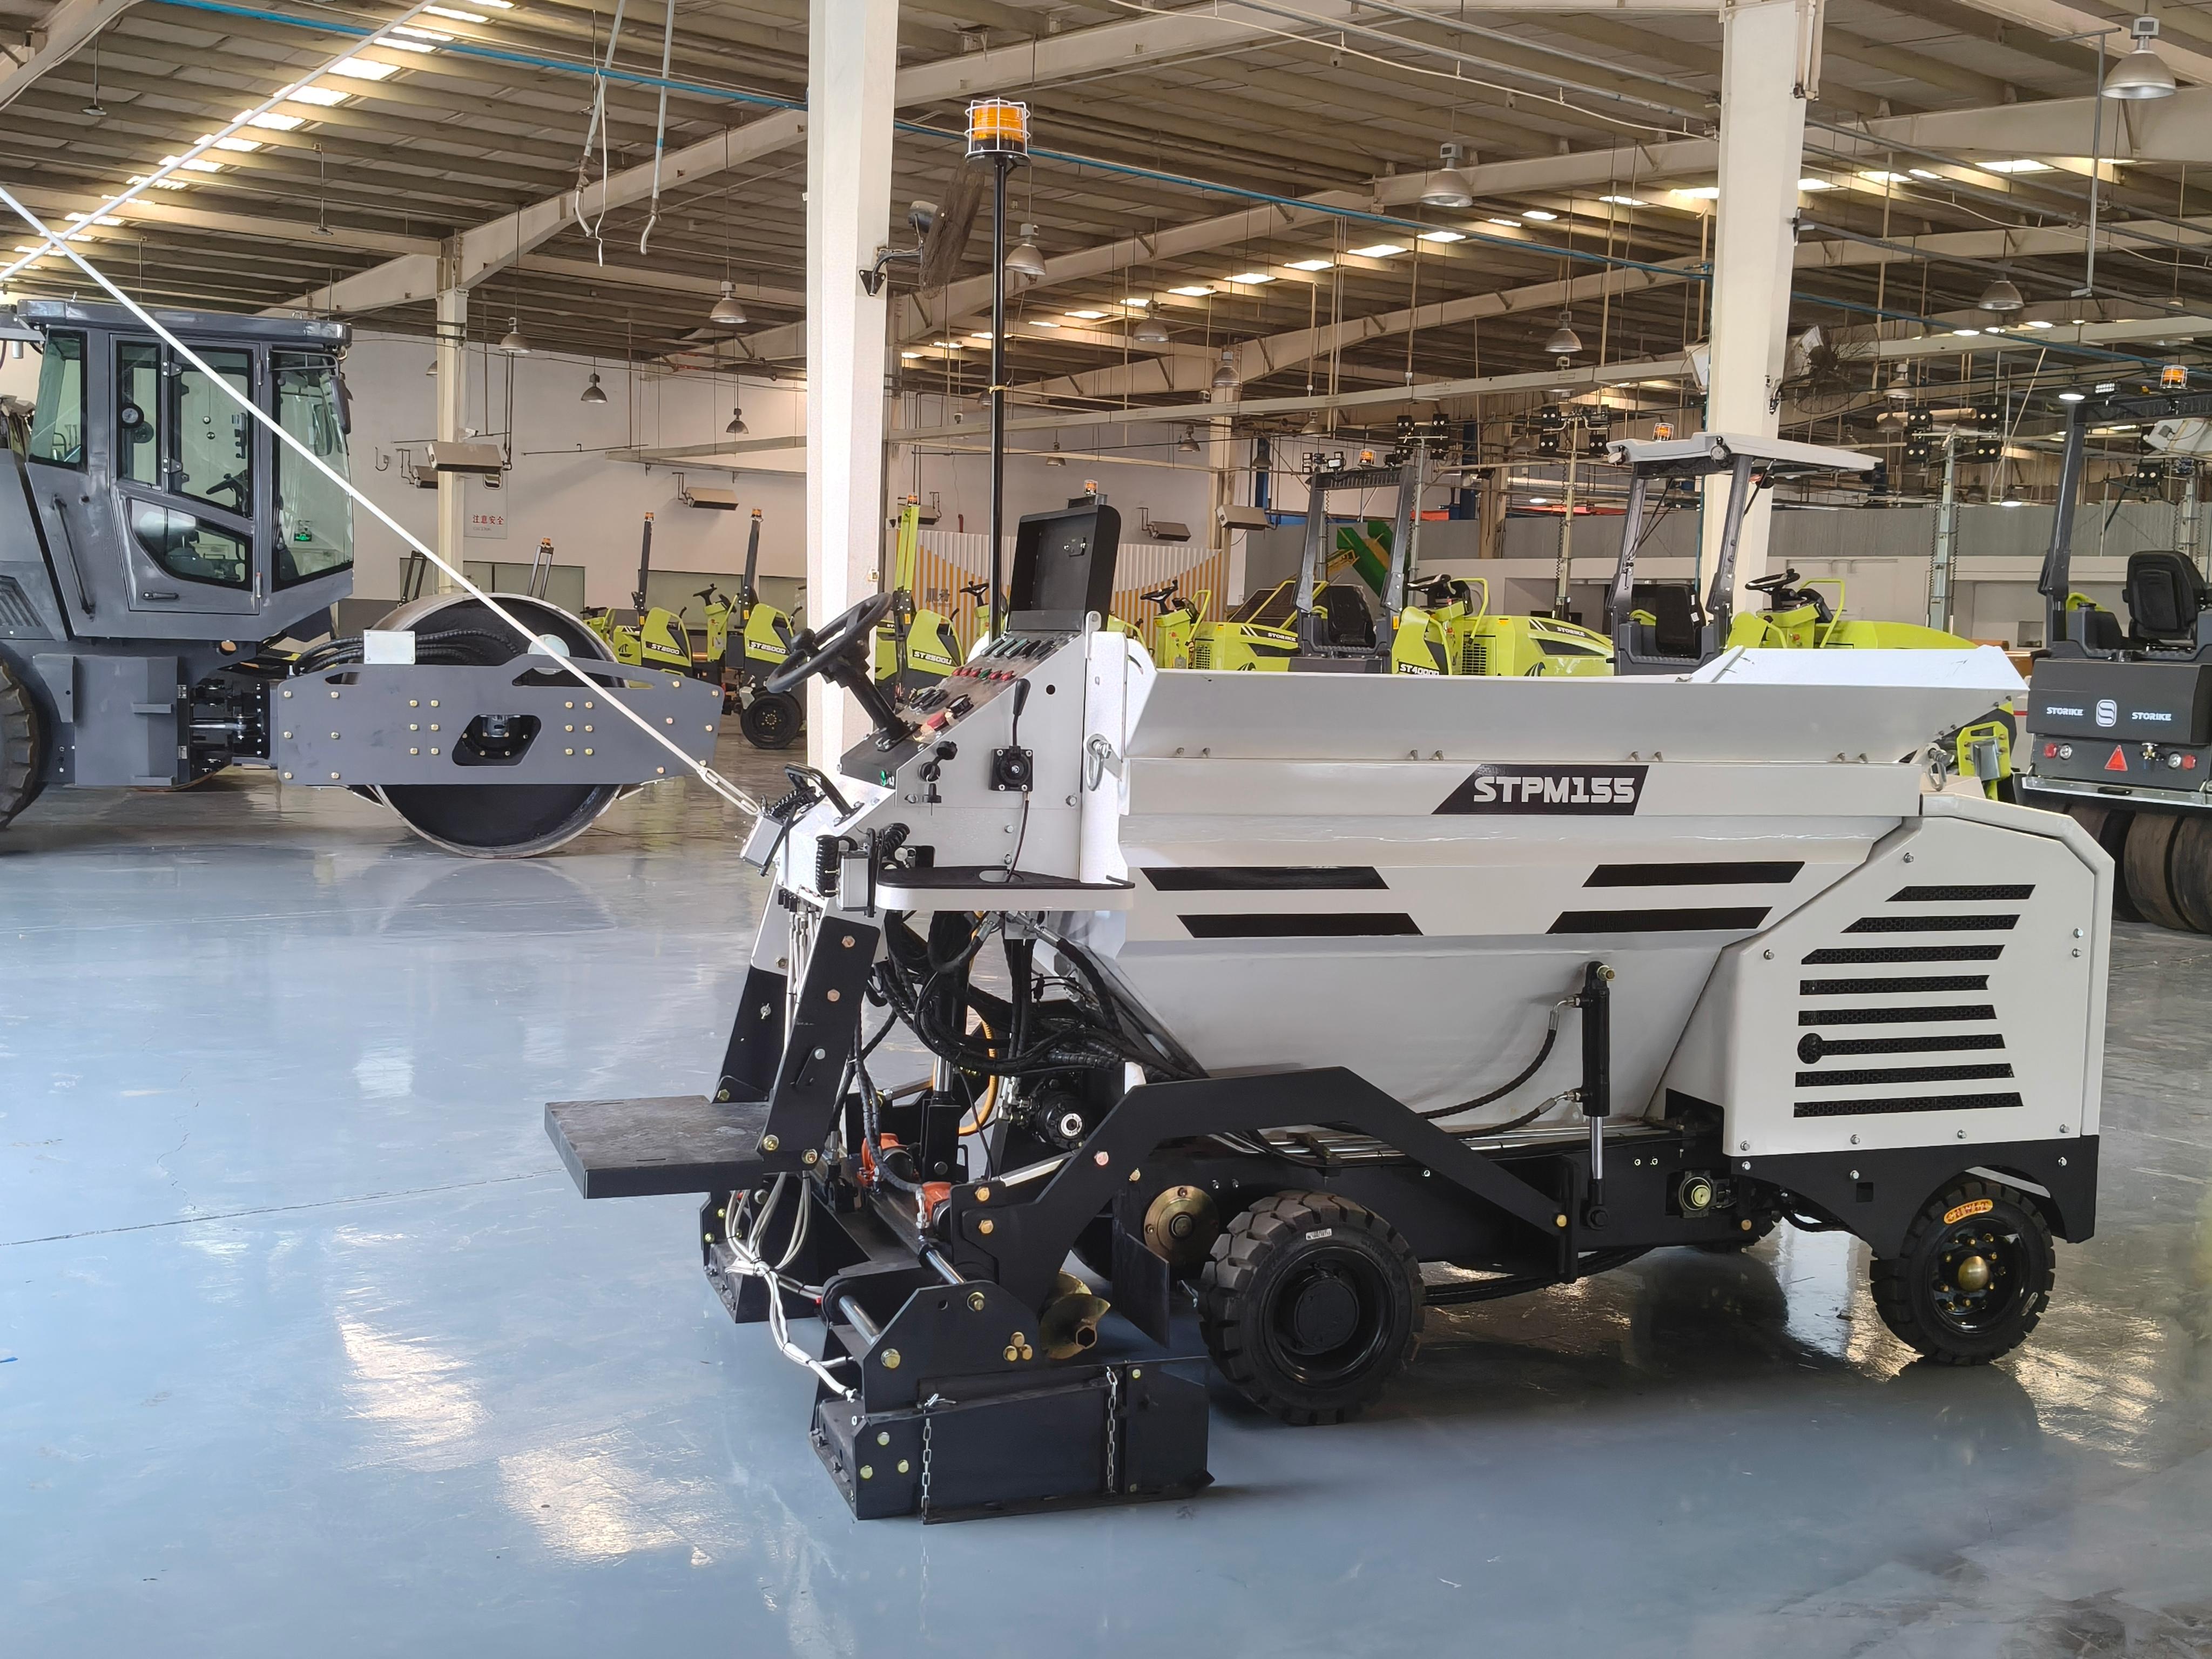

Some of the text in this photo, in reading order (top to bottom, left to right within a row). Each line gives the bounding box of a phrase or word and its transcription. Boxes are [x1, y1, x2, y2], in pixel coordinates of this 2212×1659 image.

[473, 514, 504, 524] 注意安全
[1556, 626, 1586, 637] STORIKE
[1267, 632, 1296, 642] STORIKE
[2046, 707, 2083, 716] STORIKE
[2132, 712, 2171, 721] STORIKE
[1473, 776, 1635, 804] STPM155
